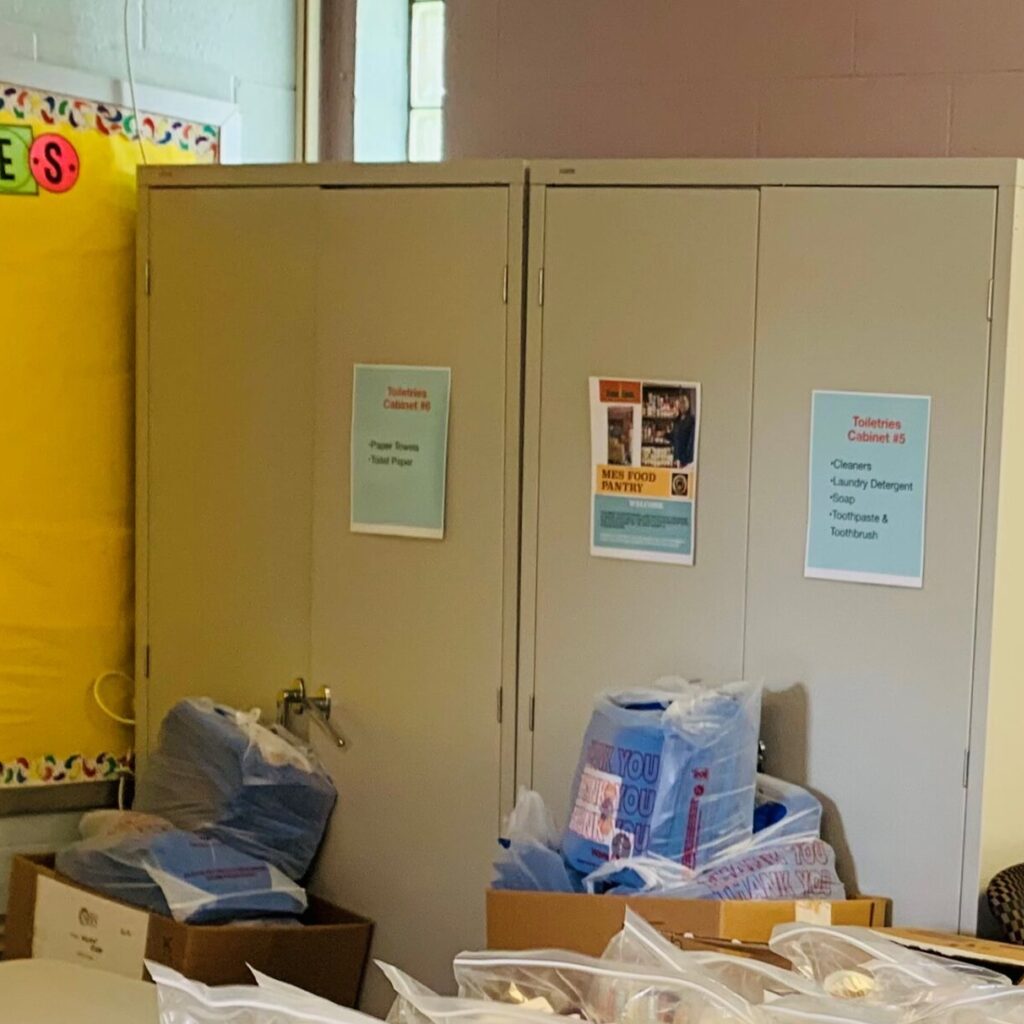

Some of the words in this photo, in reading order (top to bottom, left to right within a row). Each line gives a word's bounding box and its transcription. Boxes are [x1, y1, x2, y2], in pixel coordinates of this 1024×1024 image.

[387, 386, 427, 399] Toiletries
[383, 399, 418, 411] Cabinet
[852, 415, 902, 430] Toiletries
[847, 430, 890, 444] Cabinet
[893, 432, 906, 444] #5
[370, 440, 393, 451] Paper
[395, 441, 419, 452] Towels
[370, 454, 390, 465] Toilet
[391, 457, 413, 468] Paper
[832, 458, 872, 471] Cleaners
[601, 469, 625, 480] MES
[627, 471, 657, 483] FOOD
[601, 480, 644, 493] PANTRY
[832, 476, 868, 490] Laundry
[870, 478, 913, 493] Detergent
[832, 493, 856, 505] Soap
[831, 509, 880, 523] Toothpaste
[881, 513, 889, 523] &
[830, 526, 878, 540] Toothbrush
[617, 747, 661, 784] YOU
